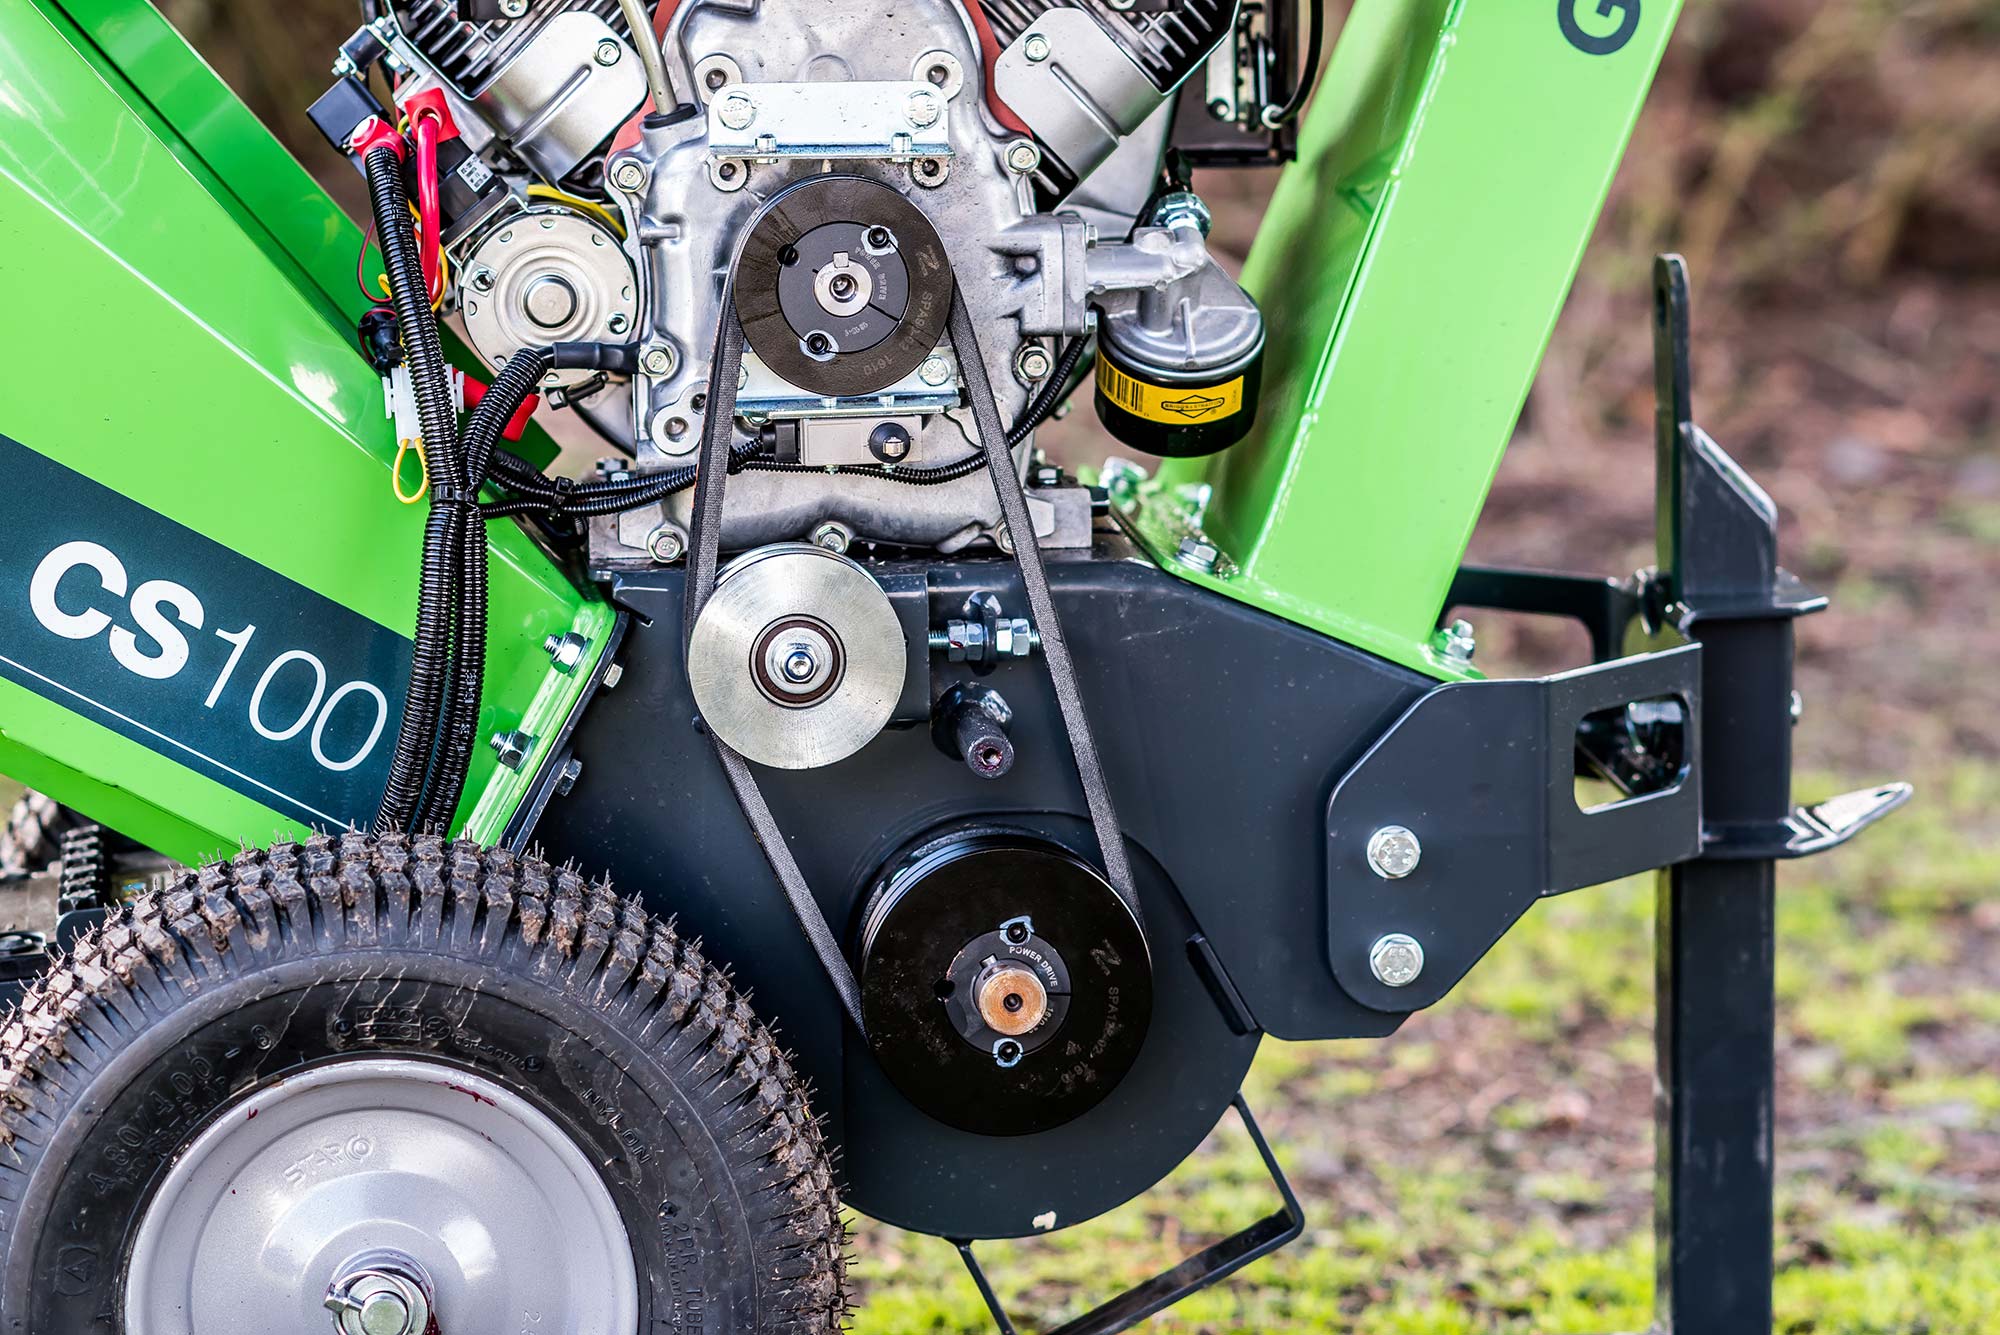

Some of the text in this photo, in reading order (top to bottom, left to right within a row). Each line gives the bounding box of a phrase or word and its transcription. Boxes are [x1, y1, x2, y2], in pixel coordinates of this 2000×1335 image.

[1557, 0, 1641, 56] G
[30, 540, 388, 772] CS100
[1009, 946, 1058, 987] POWER DRIVE
[580, 1088, 651, 1164] NYLON
